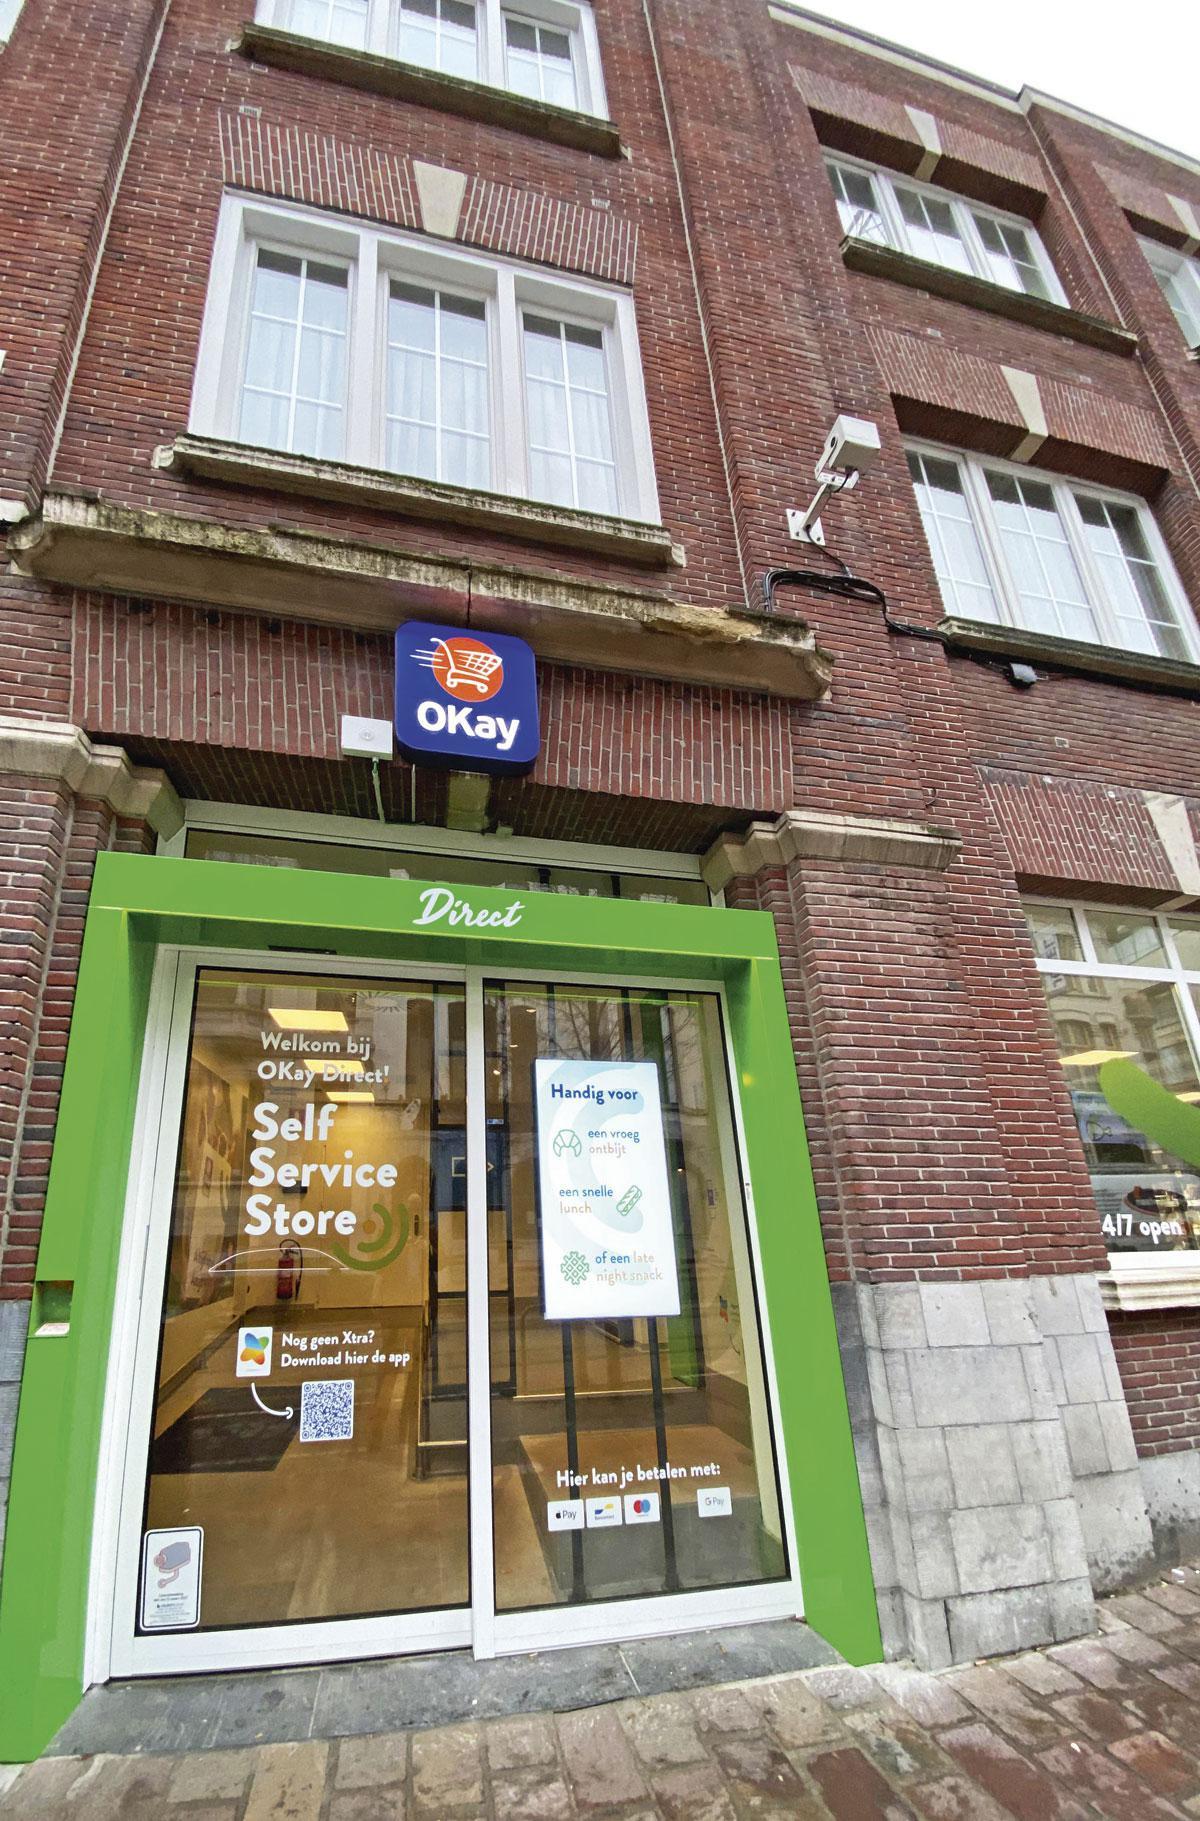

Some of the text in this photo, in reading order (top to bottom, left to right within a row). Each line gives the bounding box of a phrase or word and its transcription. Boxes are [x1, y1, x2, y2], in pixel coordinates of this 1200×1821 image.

[416, 701, 520, 750] OKay
[413, 887, 526, 928] Direct
[261, 1031, 371, 1061] Welkom bij
[257, 1060, 390, 1088] OKay Direct!
[551, 1084, 639, 1105] Handig voor
[252, 1102, 338, 1141] Self
[588, 1129, 640, 1143] een vroeg
[589, 1143, 627, 1158] ontbijt
[248, 1147, 398, 1188] Service
[559, 1185, 614, 1197] een snelle
[244, 1194, 357, 1236] Store
[559, 1199, 592, 1214] lunch
[1139, 1221, 1185, 1245] open
[595, 1251, 655, 1264] of een late
[596, 1268, 664, 1286] night snack
[282, 1330, 375, 1350] Nog geen Xtra?
[280, 1350, 411, 1368] Download hier de app
[556, 1462, 721, 1489] Hier kan je betalen met:
[562, 1510, 577, 1520] Pay
